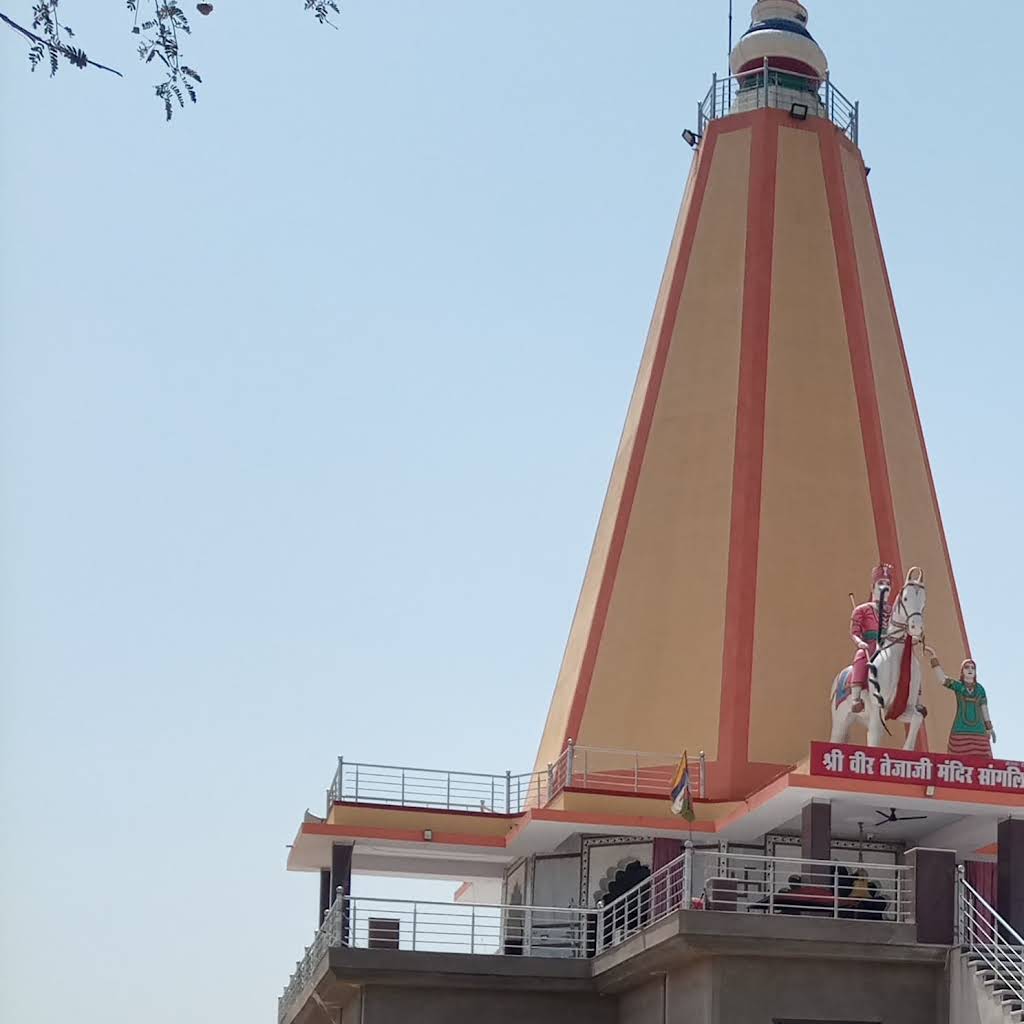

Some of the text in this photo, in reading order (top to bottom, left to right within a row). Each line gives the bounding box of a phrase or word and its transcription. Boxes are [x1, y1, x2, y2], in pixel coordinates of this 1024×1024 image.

[822, 748, 845, 772] श्री
[849, 750, 875, 775] वीर
[880, 752, 933, 780] तेजाजी
[936, 759, 975, 784] मंदिर
